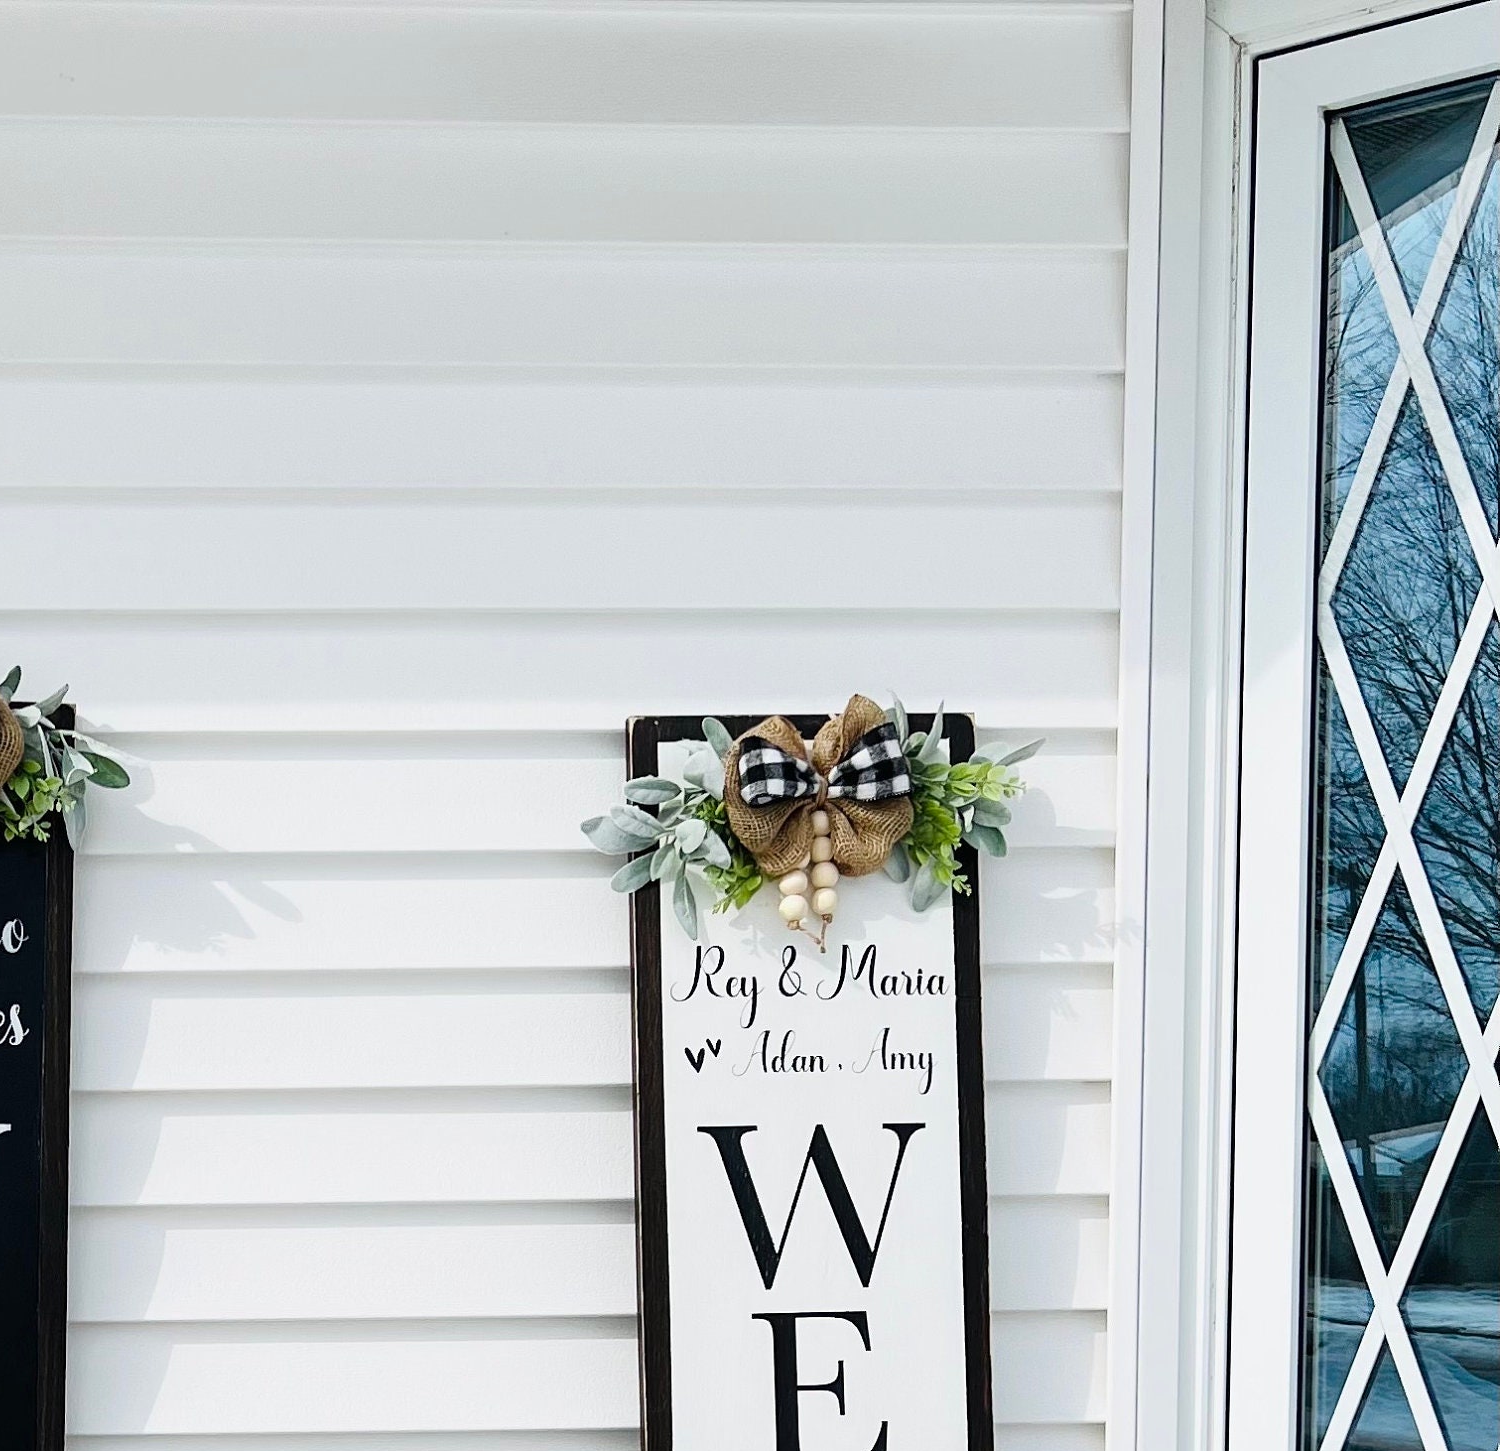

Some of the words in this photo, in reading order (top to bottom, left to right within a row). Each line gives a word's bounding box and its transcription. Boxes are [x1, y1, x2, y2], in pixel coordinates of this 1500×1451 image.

[670, 945, 764, 1028] Rey
[778, 945, 807, 997] &
[816, 944, 950, 1000] Maria
[852, 1028, 936, 1094] Amy
